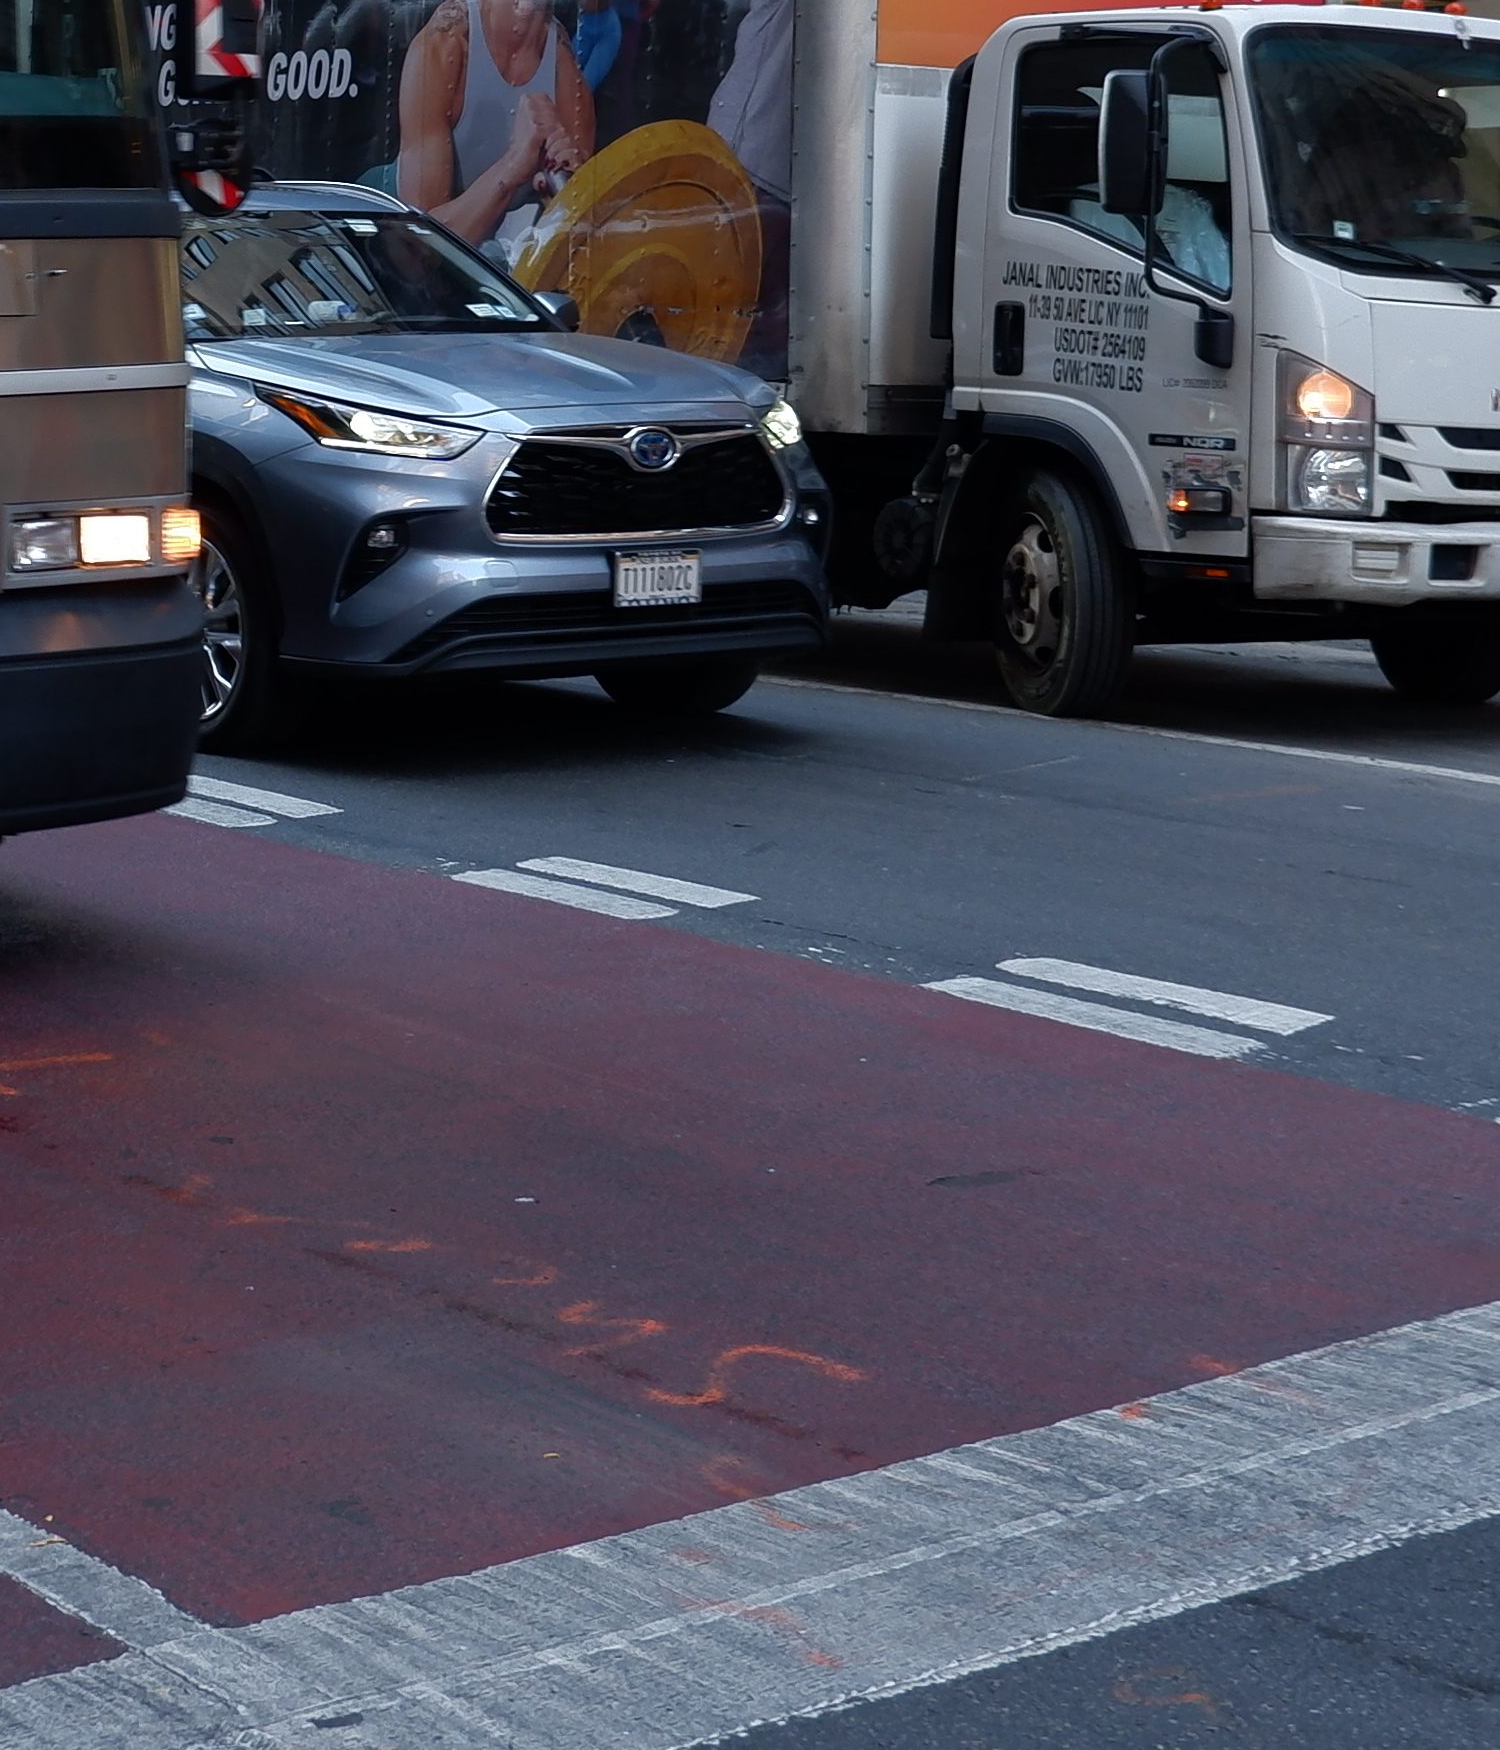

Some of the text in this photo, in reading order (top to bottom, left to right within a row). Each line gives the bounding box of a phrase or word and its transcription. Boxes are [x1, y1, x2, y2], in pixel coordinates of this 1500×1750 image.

[266, 48, 359, 102] GOOD.
[1002, 261, 1150, 299] JANAL INDUSTRIES INC.
[1065, 298, 1087, 324] AVE
[1087, 300, 1104, 326] LIC
[1106, 301, 1122, 328] NY
[1123, 303, 1150, 331] 11101
[1054, 327, 1147, 362] USDOT# 2564109
[1118, 363, 1144, 393] LBS
[1182, 437, 1226, 449] NQR
